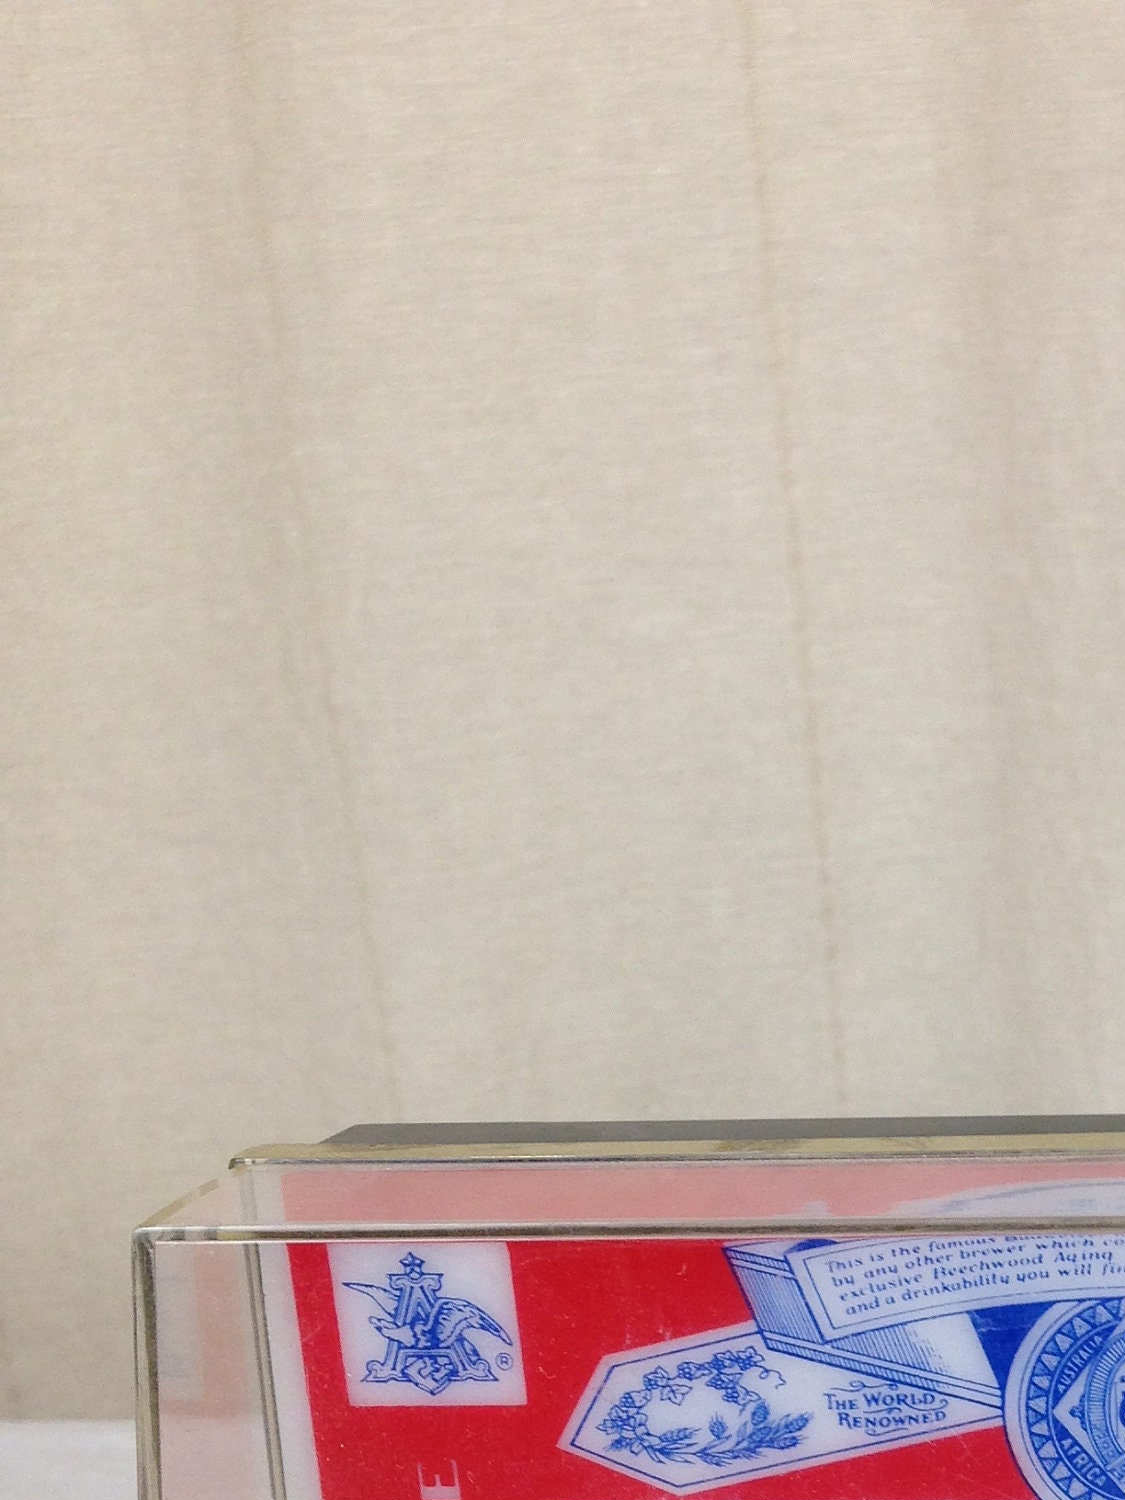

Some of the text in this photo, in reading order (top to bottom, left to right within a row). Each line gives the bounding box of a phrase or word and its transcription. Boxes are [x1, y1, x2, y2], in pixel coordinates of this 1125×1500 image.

[826, 1258, 863, 1274] This
[869, 1253, 885, 1264] is
[890, 1246, 921, 1259] the
[928, 1236, 997, 1252] famous
[830, 1275, 856, 1288] by
[863, 1265, 899, 1280] any
[904, 1253, 954, 1270] other
[959, 1244, 1026, 1261] brewer
[1034, 1238, 1095, 1250] which
[839, 1273, 924, 1301] exclusive
[932, 1253, 1045, 1280] Beechwood
[1053, 1250, 1114, 1264] Aging
[845, 1296, 880, 1316] and
[884, 1295, 896, 1305] a
[901, 1272, 1010, 1302] drinkability
[1016, 1270, 1050, 1284] you
[1056, 1263, 1092, 1276] will
[1056, 1334, 1104, 1396] AUSTRALIA
[837, 1411, 947, 1430] RENOWNED
[862, 1391, 937, 1408] WORLD
[1060, 1437, 1108, 1488] AFRICA
